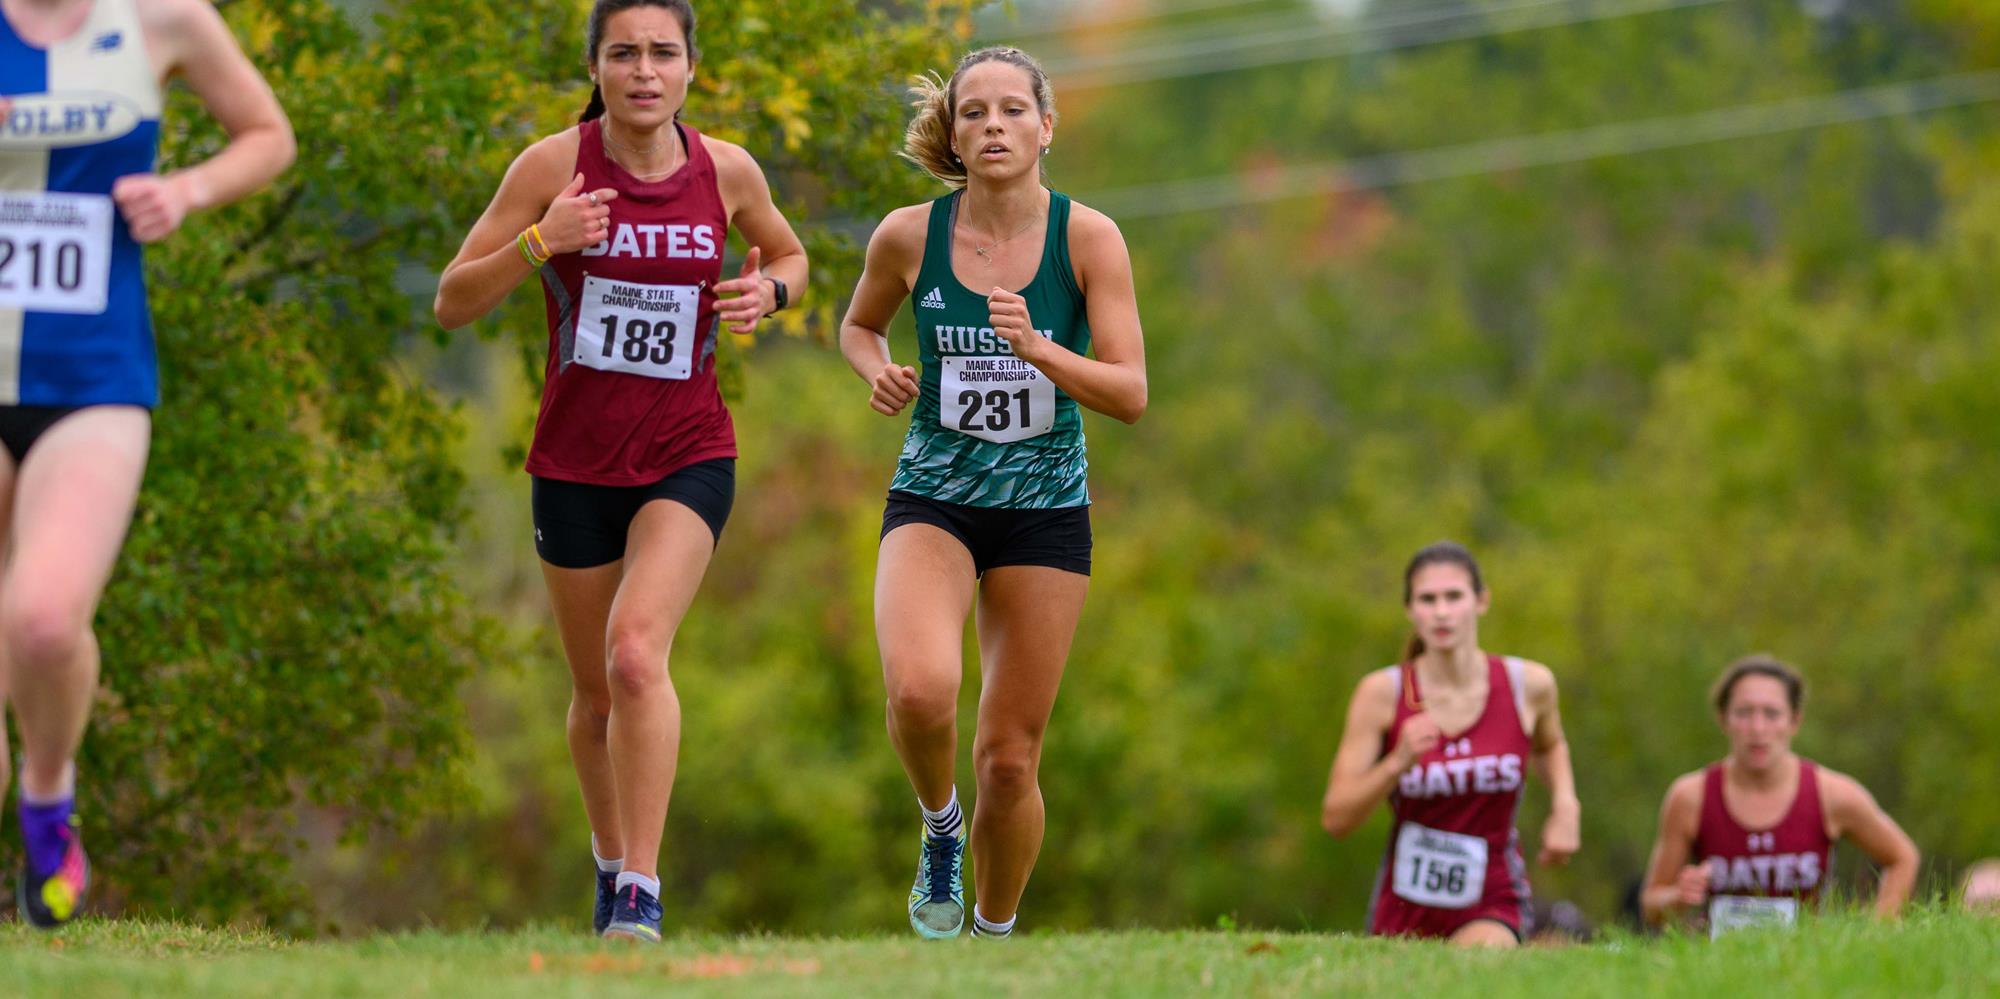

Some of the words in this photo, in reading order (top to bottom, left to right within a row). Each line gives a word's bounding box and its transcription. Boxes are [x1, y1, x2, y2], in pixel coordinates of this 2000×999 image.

[0, 103, 112, 135] OLBY
[0, 238, 84, 292] 210
[602, 294, 680, 313] CHAMPIONSHIPS
[612, 285, 643, 299] MAINE
[646, 289, 674, 301] STATE
[920, 300, 946, 310] adidas
[600, 314, 676, 365] 183
[959, 370, 1037, 382] CHAMPIONSHIPS
[965, 359, 996, 371] MAINE
[998, 359, 1028, 371] STATE
[958, 388, 1031, 431] 231
[1411, 856, 1467, 896] 156
